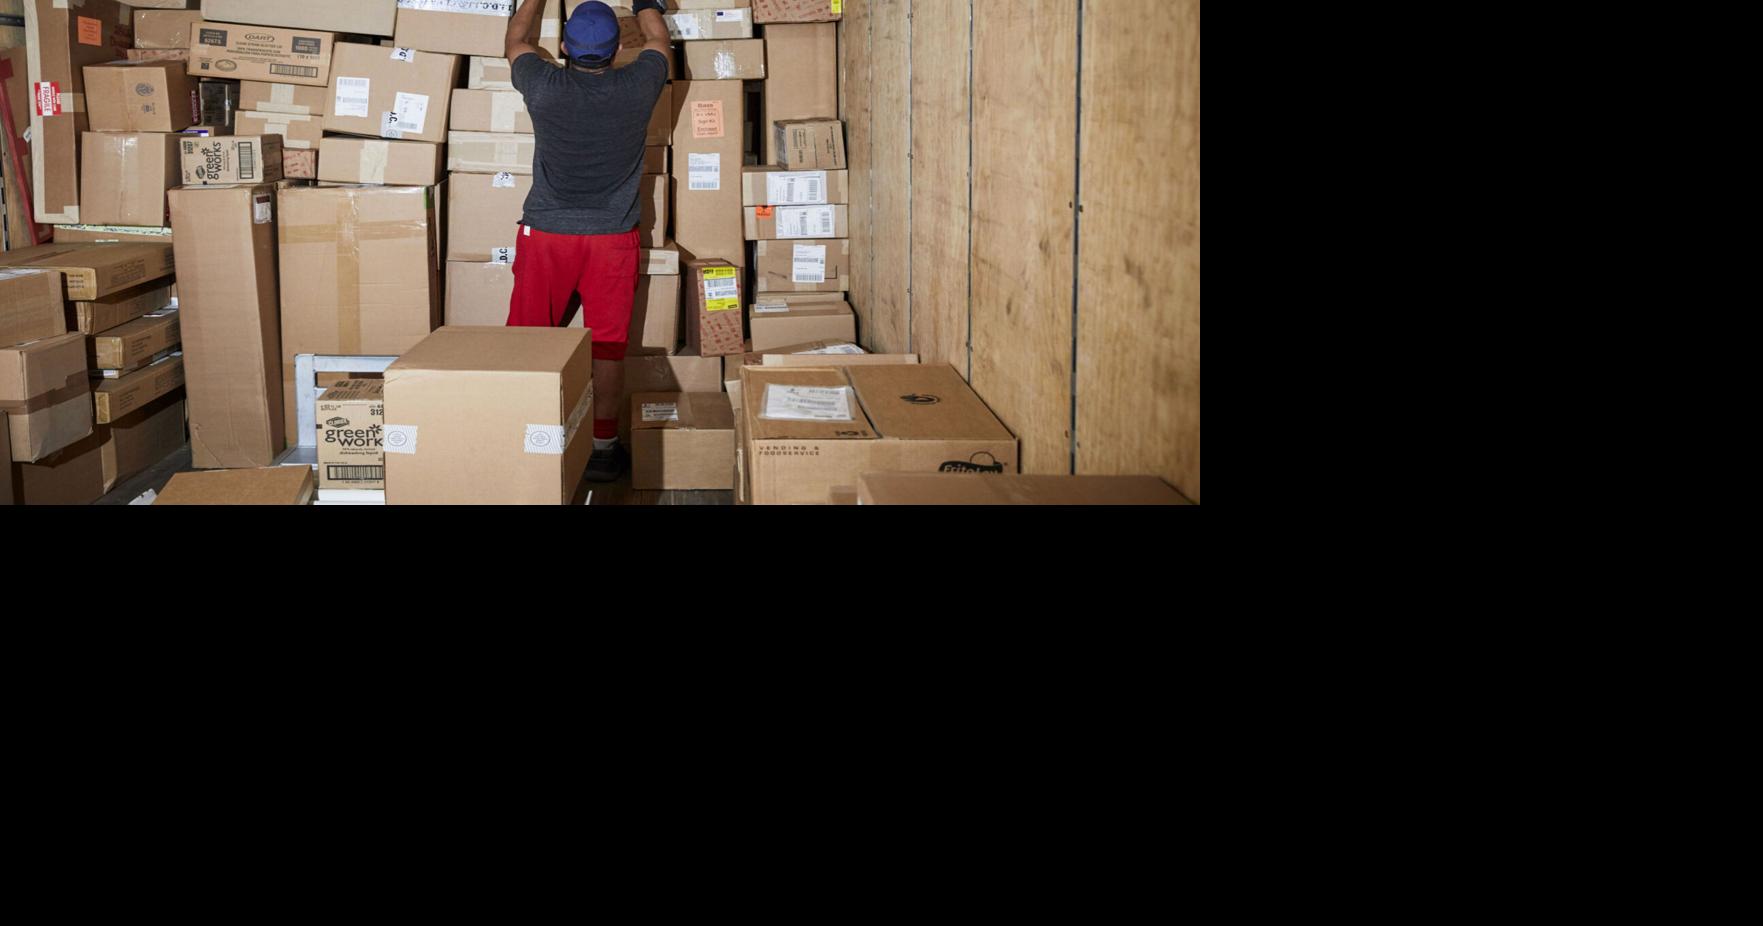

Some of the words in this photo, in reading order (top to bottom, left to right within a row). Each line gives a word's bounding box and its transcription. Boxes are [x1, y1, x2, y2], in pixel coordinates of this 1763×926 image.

[42, 86, 51, 113] FRAGILE
[205, 151, 219, 181] green
[212, 142, 222, 172] works
[370, 408, 384, 416] 312
[325, 429, 377, 443] green
[338, 437, 384, 447] work
